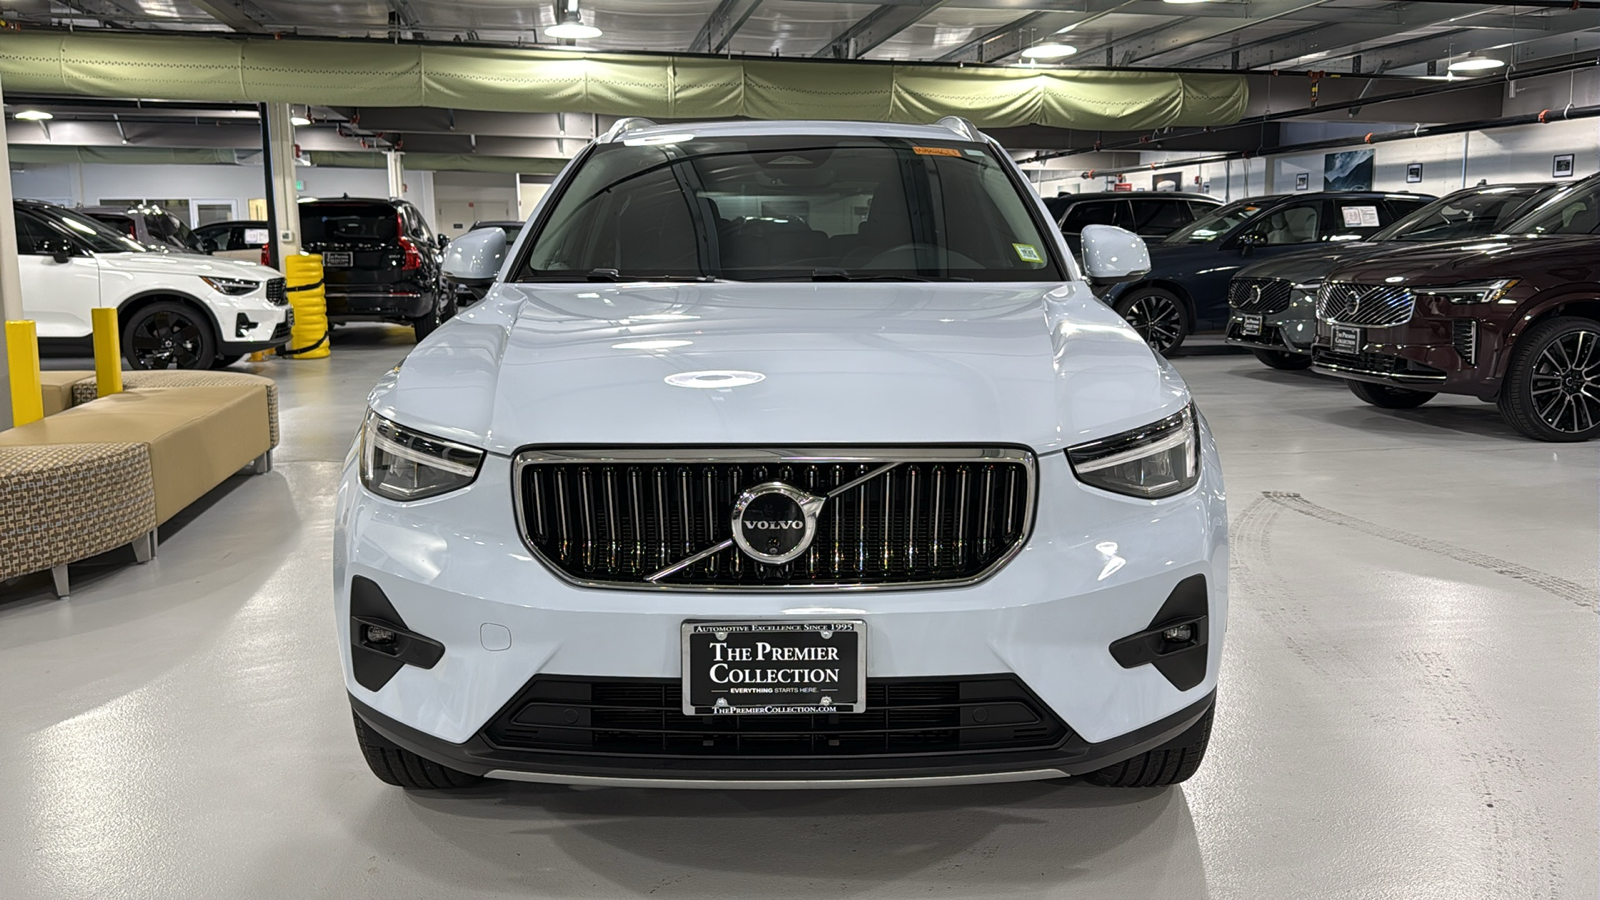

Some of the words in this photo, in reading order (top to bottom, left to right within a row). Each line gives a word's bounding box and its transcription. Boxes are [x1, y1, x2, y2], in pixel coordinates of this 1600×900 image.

[743, 520, 803, 529] VOLVO
[709, 642, 752, 661] THE
[755, 642, 840, 661] PREMIER
[709, 663, 840, 683] COLLECTION
